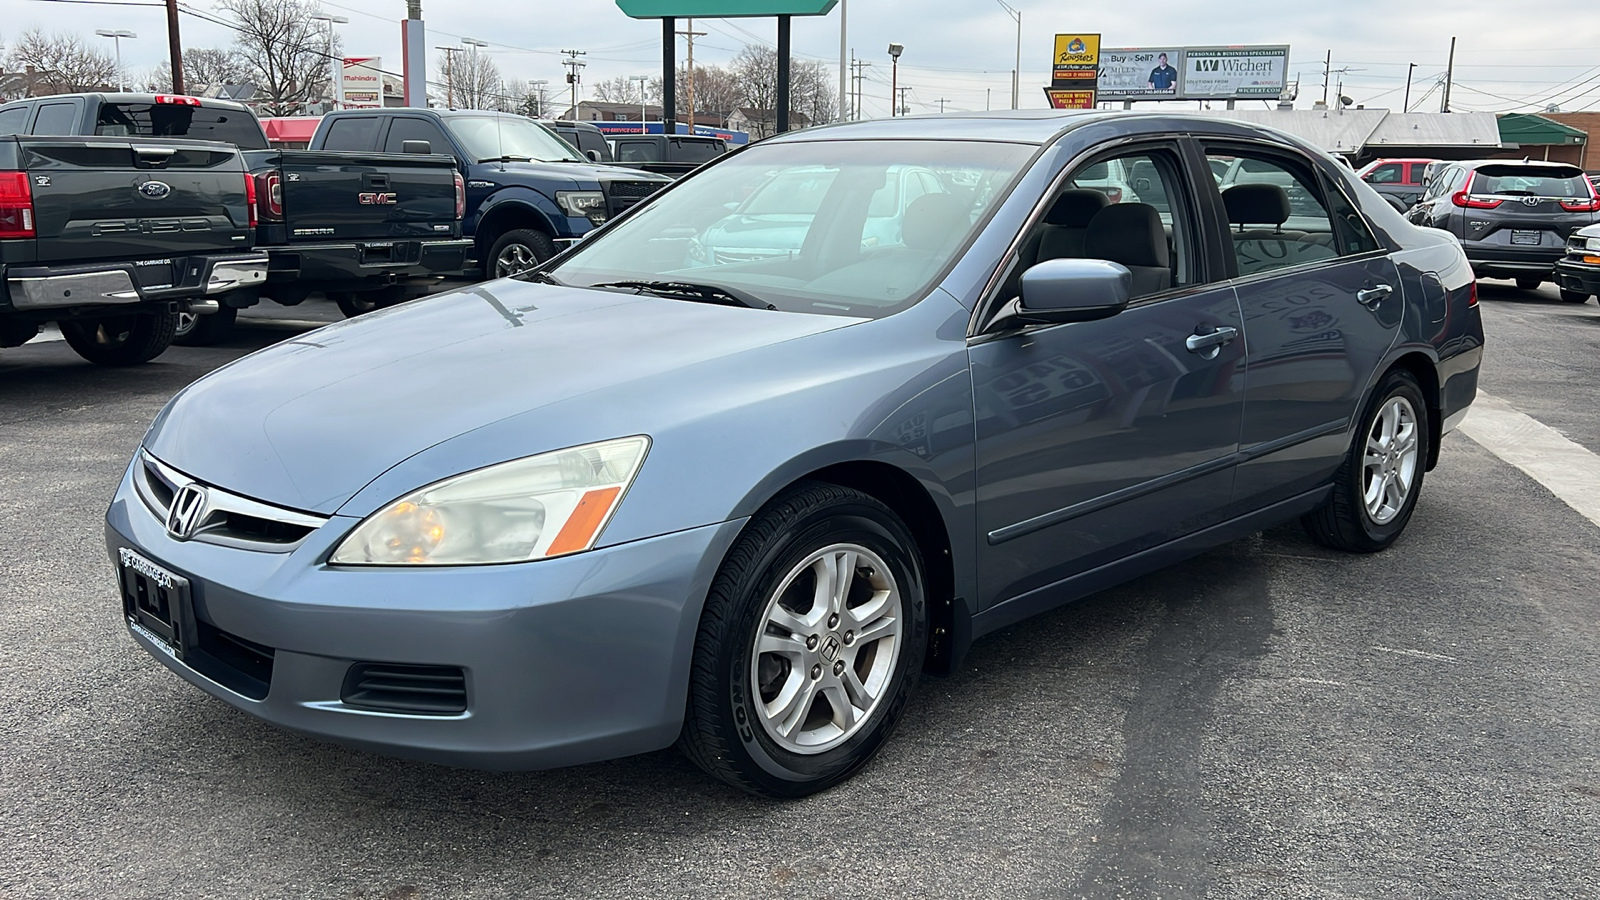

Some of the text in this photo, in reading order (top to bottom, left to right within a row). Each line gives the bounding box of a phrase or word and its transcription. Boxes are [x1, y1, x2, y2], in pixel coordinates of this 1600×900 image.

[1059, 52, 1094, 63] Roosters
[1111, 55, 1127, 63] Buy
[1135, 54, 1154, 62] Sell?
[1221, 58, 1273, 72] Wichert
[358, 192, 397, 205] GMC
[118, 550, 132, 567] THE
[131, 557, 161, 581] CARRIAGE
